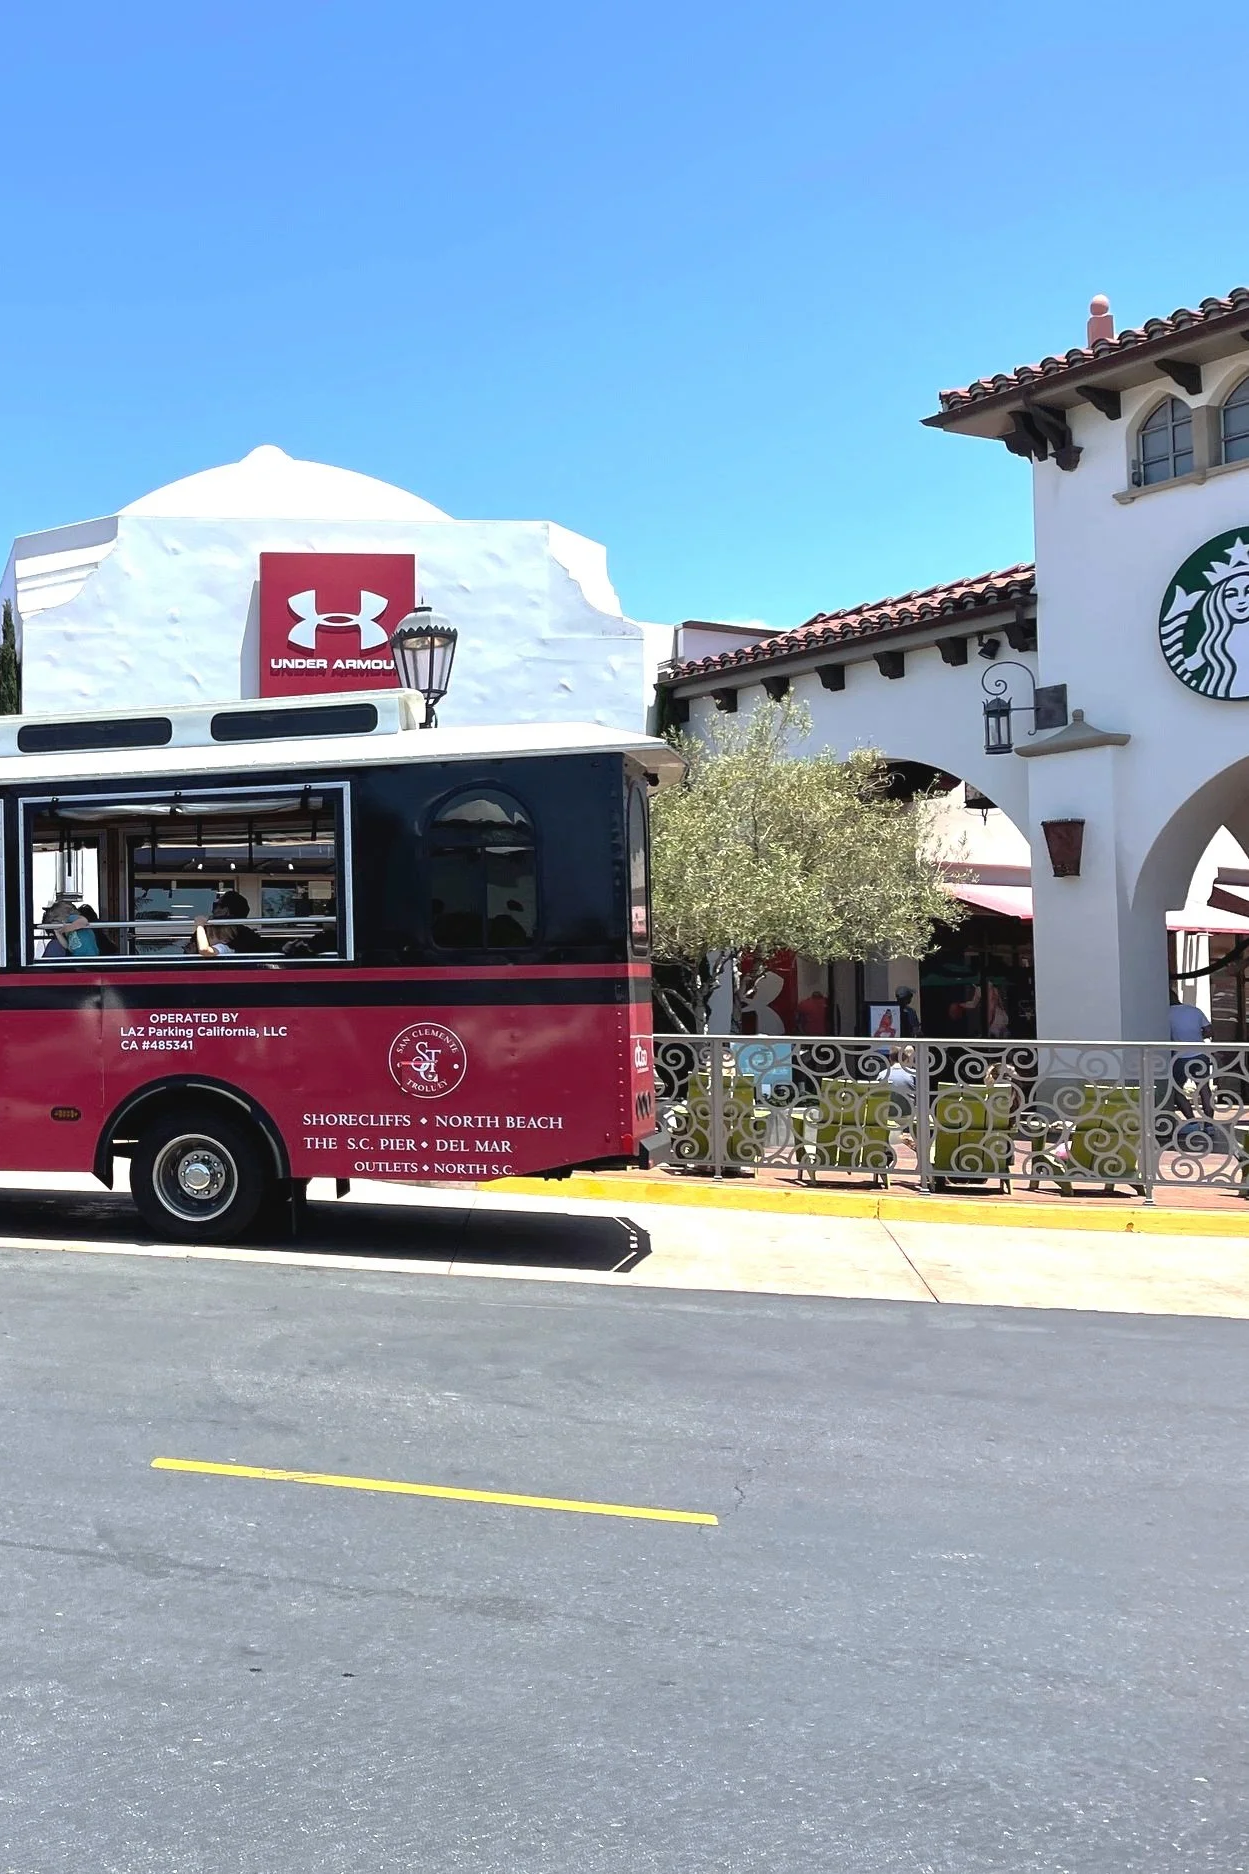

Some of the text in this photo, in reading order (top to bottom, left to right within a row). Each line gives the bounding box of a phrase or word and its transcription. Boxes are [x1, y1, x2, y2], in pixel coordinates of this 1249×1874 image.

[270, 658, 396, 670] UNDER ARMOU
[150, 1013, 239, 1024] OPERATED BY
[120, 1026, 288, 1039] LAZ Parking California, LLC
[120, 1040, 193, 1051] CA #485341
[396, 1028, 459, 1054] SAN CLEMENTE
[303, 1113, 563, 1129] SHORECLIFFS NORTH BEACH
[303, 1137, 513, 1153] THE S.C. PIER DEL MAR
[354, 1161, 516, 1176] OUTLETS NORTH S.C.
